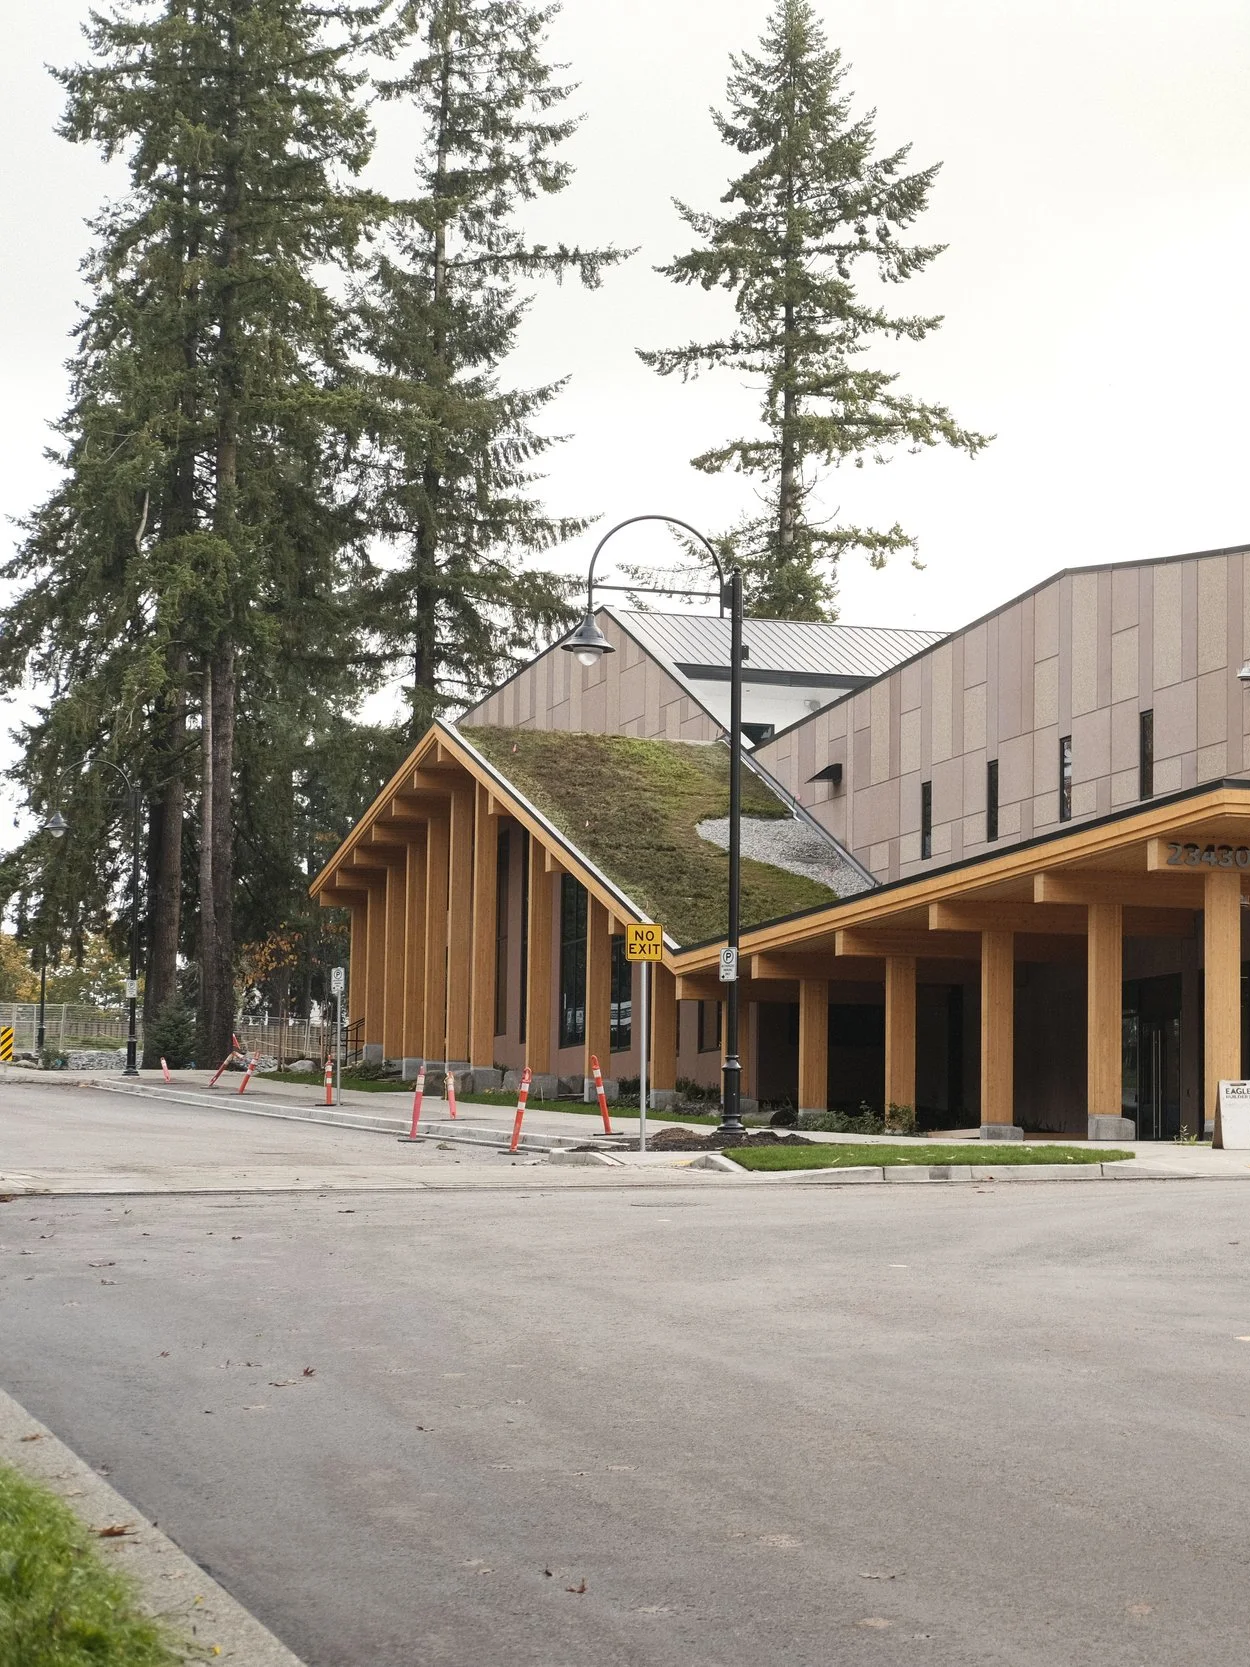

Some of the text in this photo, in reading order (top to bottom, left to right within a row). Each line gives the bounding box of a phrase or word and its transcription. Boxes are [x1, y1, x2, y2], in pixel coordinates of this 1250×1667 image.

[634, 930, 655, 942] NO
[629, 943, 661, 955] EXIT
[725, 952, 732, 961] P
